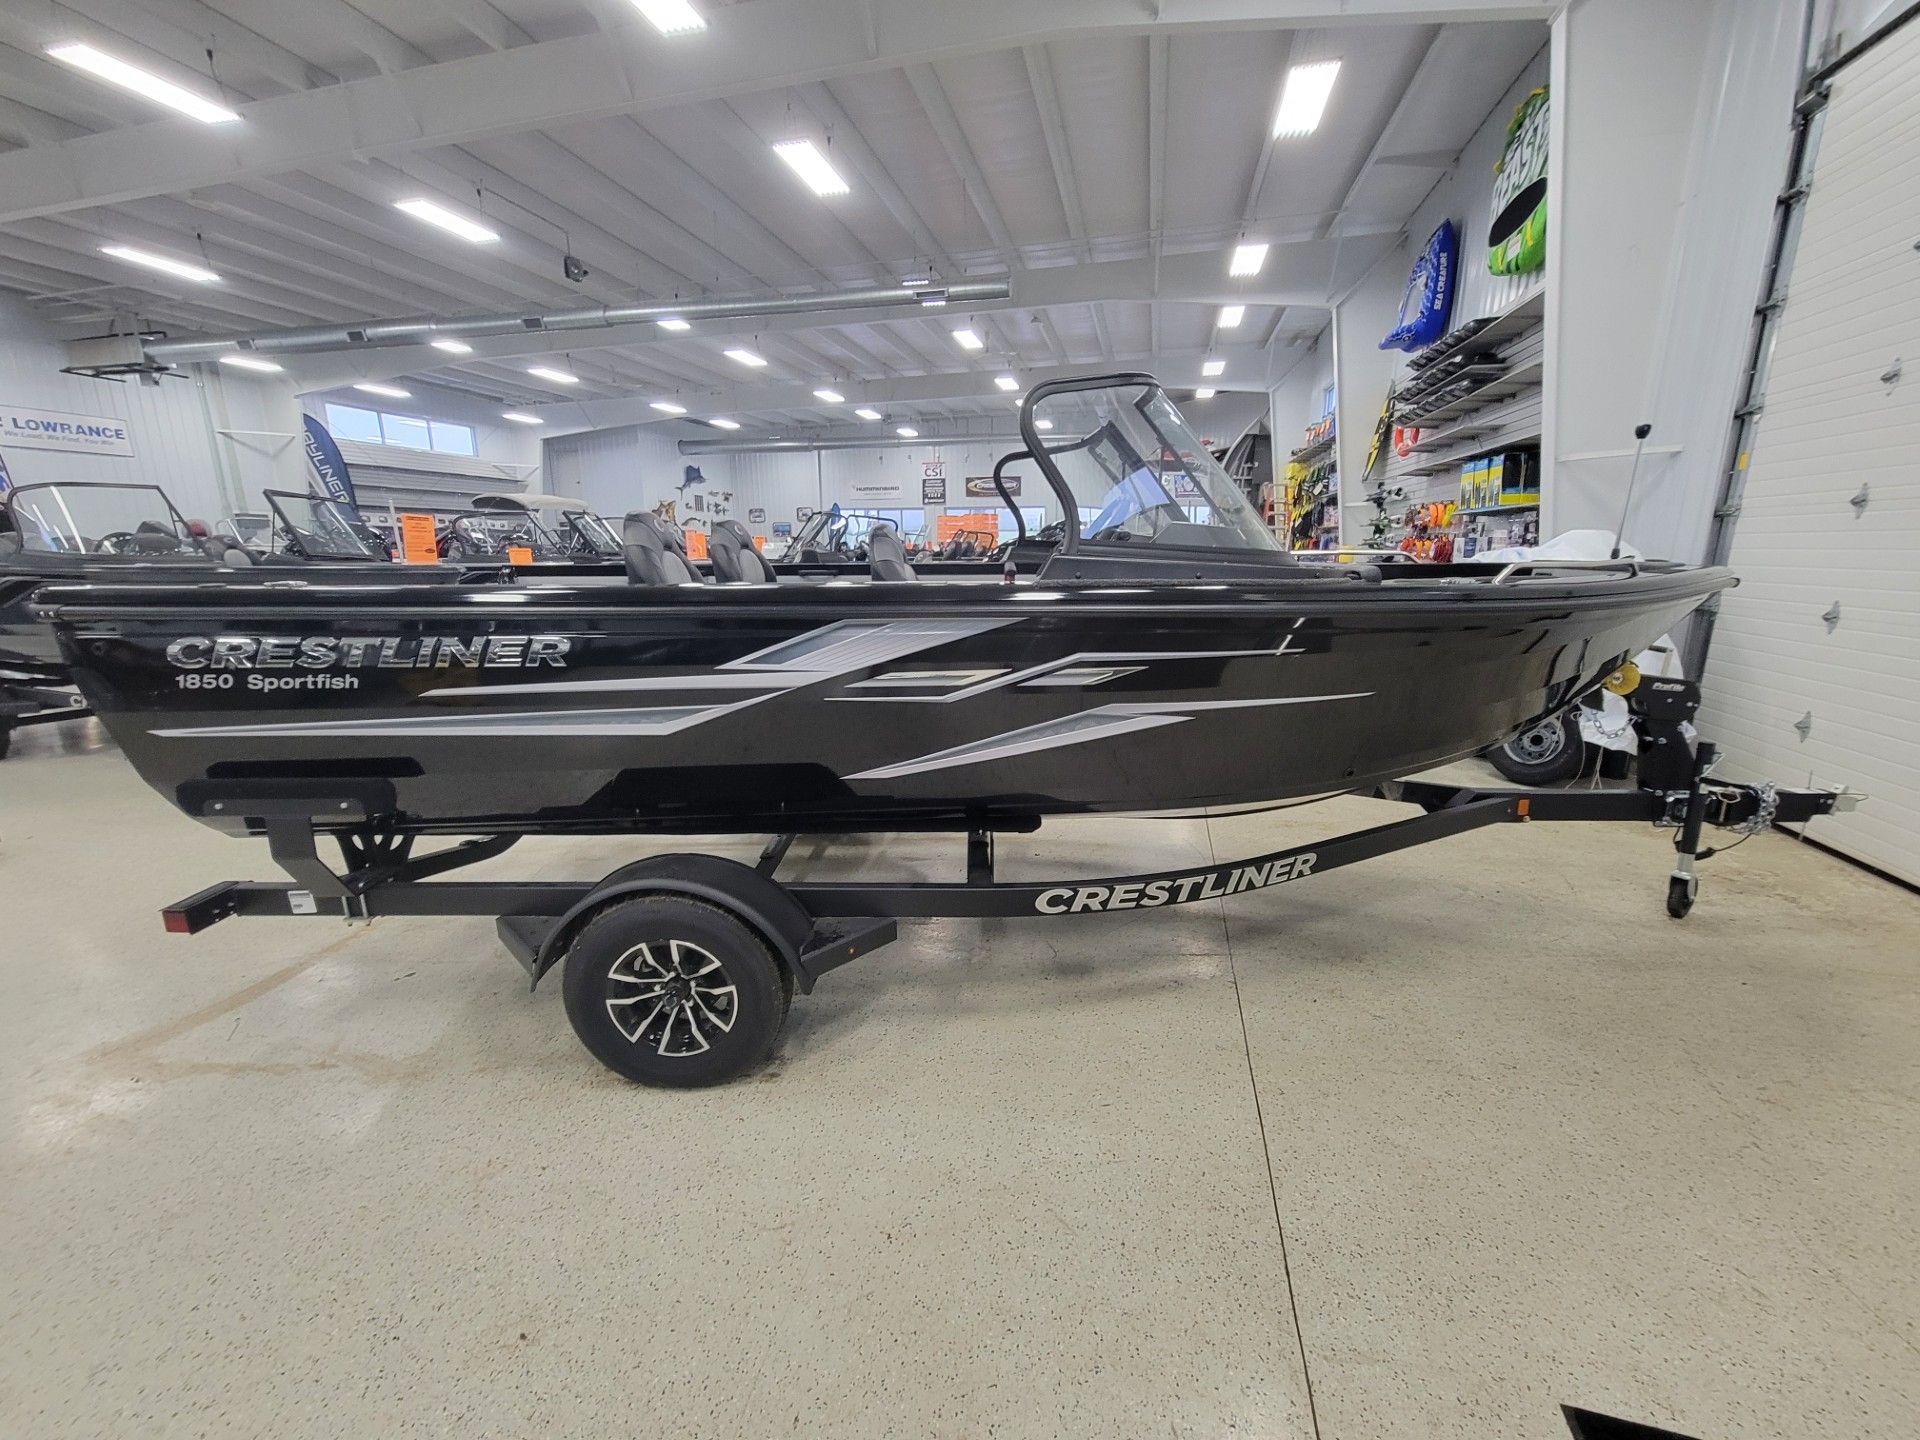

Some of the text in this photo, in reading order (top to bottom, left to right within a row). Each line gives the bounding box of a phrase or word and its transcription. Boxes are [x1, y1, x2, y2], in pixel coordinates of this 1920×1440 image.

[11, 417, 125, 439] LOWRANCE
[924, 468, 942, 477] CSI
[166, 636, 571, 669] CRESTLINER
[175, 673, 359, 692] 1850 Sportfish
[1034, 852, 1318, 914] CRESTLINER
